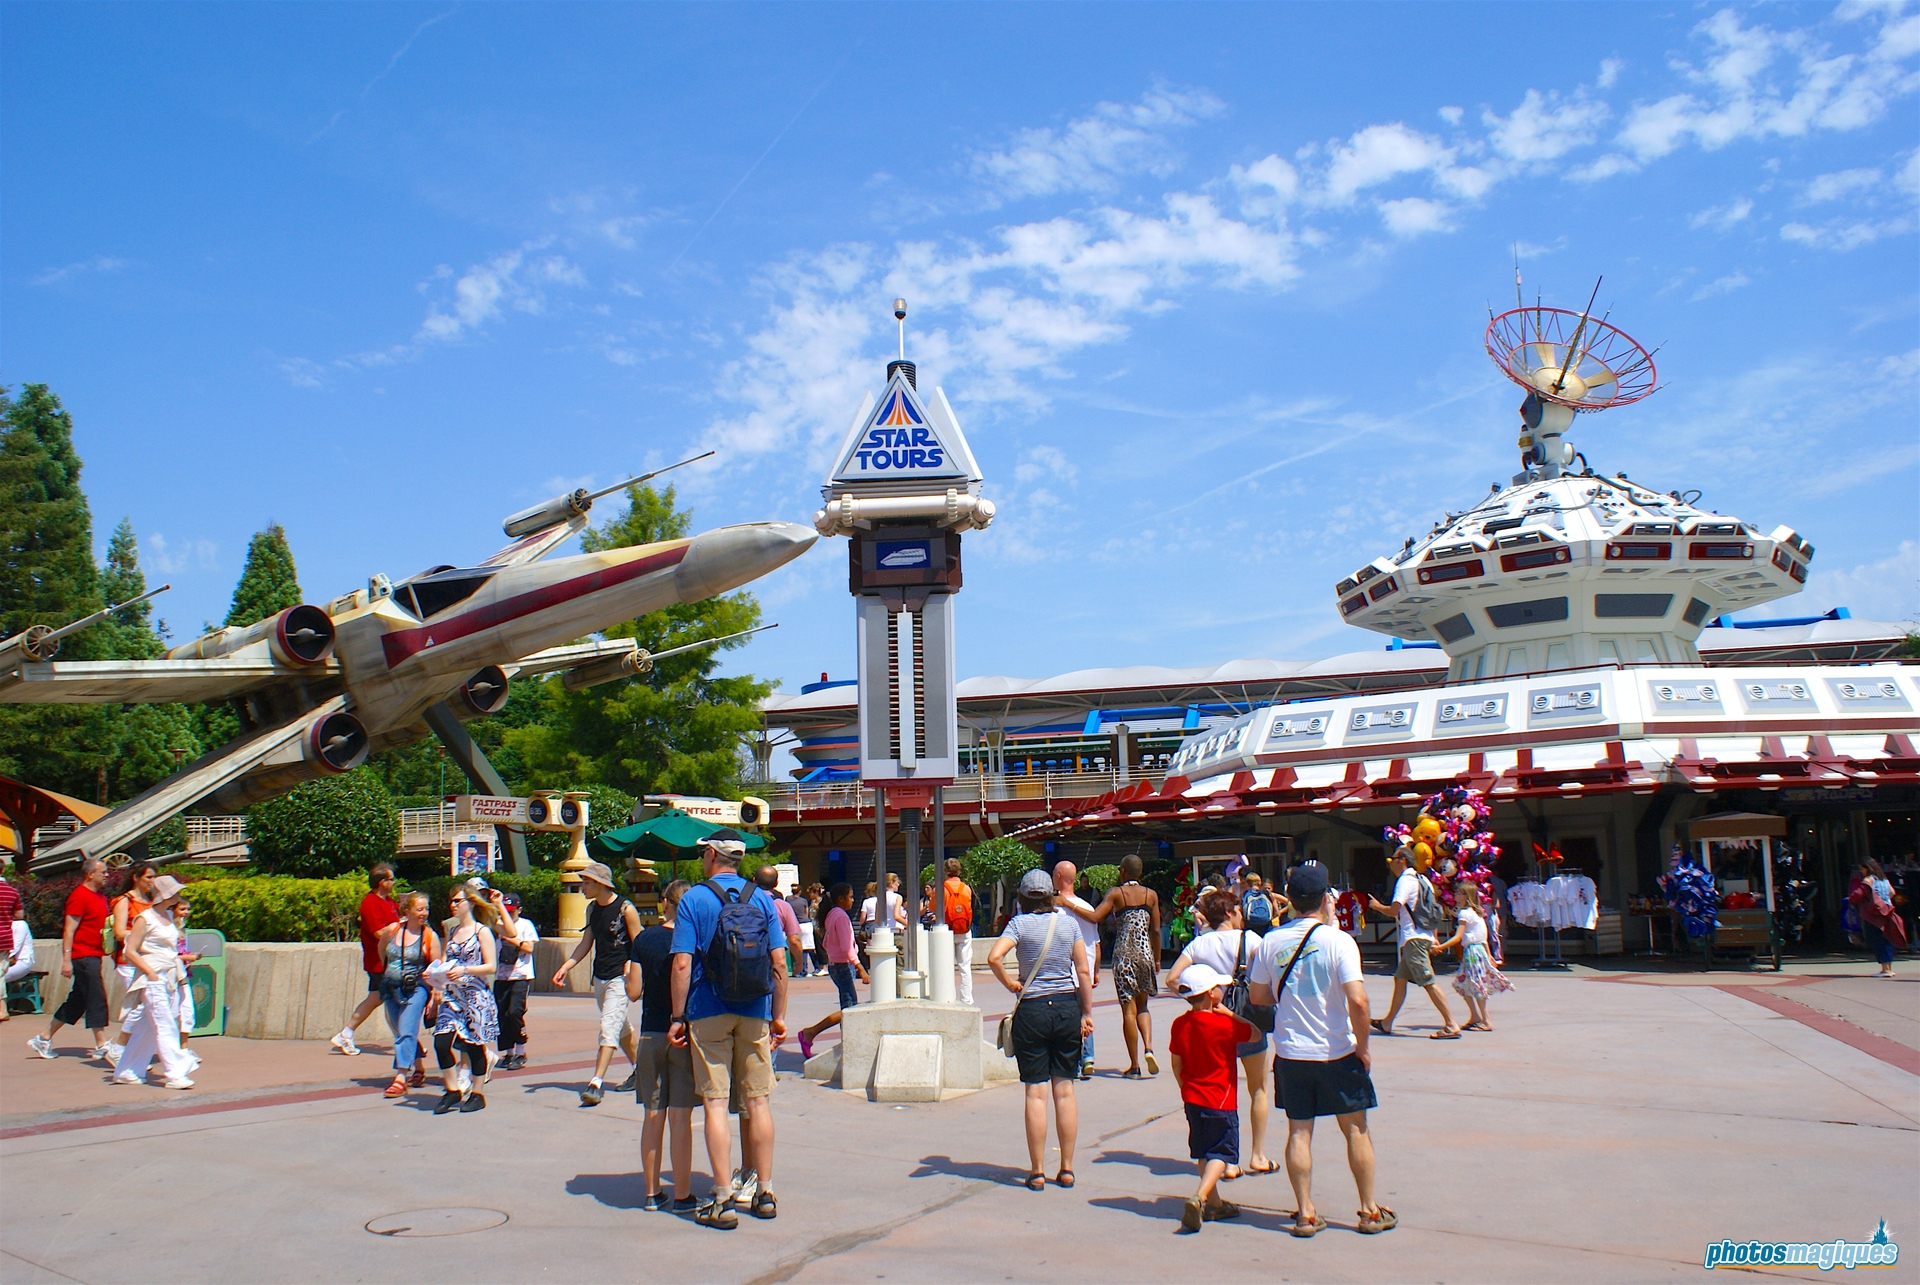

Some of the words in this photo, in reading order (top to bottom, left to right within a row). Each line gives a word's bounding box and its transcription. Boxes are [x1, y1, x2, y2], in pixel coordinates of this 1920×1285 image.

[860, 428, 939, 449] STAR
[855, 449, 944, 470] TOURS
[472, 799, 517, 808] FASTPASS
[475, 807, 512, 817] TICKETS
